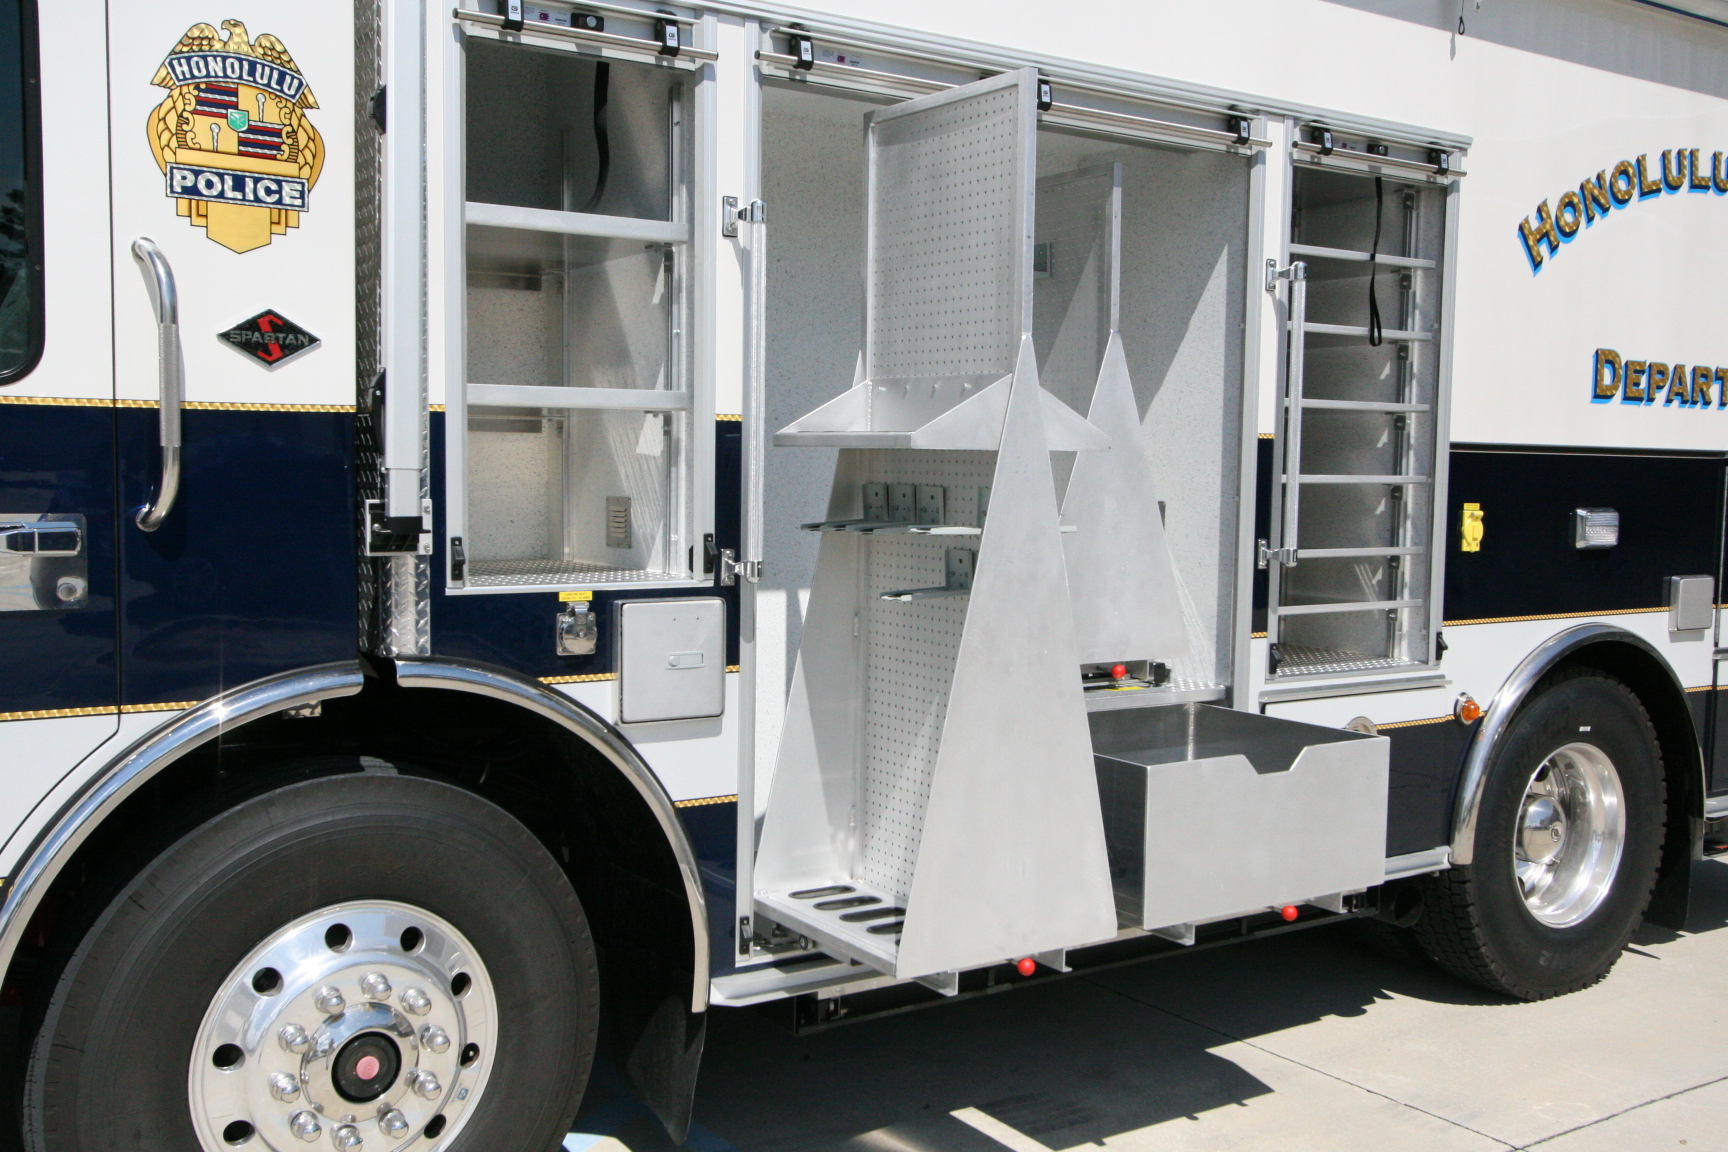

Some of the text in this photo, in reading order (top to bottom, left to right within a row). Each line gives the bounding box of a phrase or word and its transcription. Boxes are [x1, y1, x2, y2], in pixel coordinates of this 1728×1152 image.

[171, 56, 300, 97] HONOLULU
[172, 167, 303, 206] POLICE
[228, 330, 310, 346] SPARTAN
